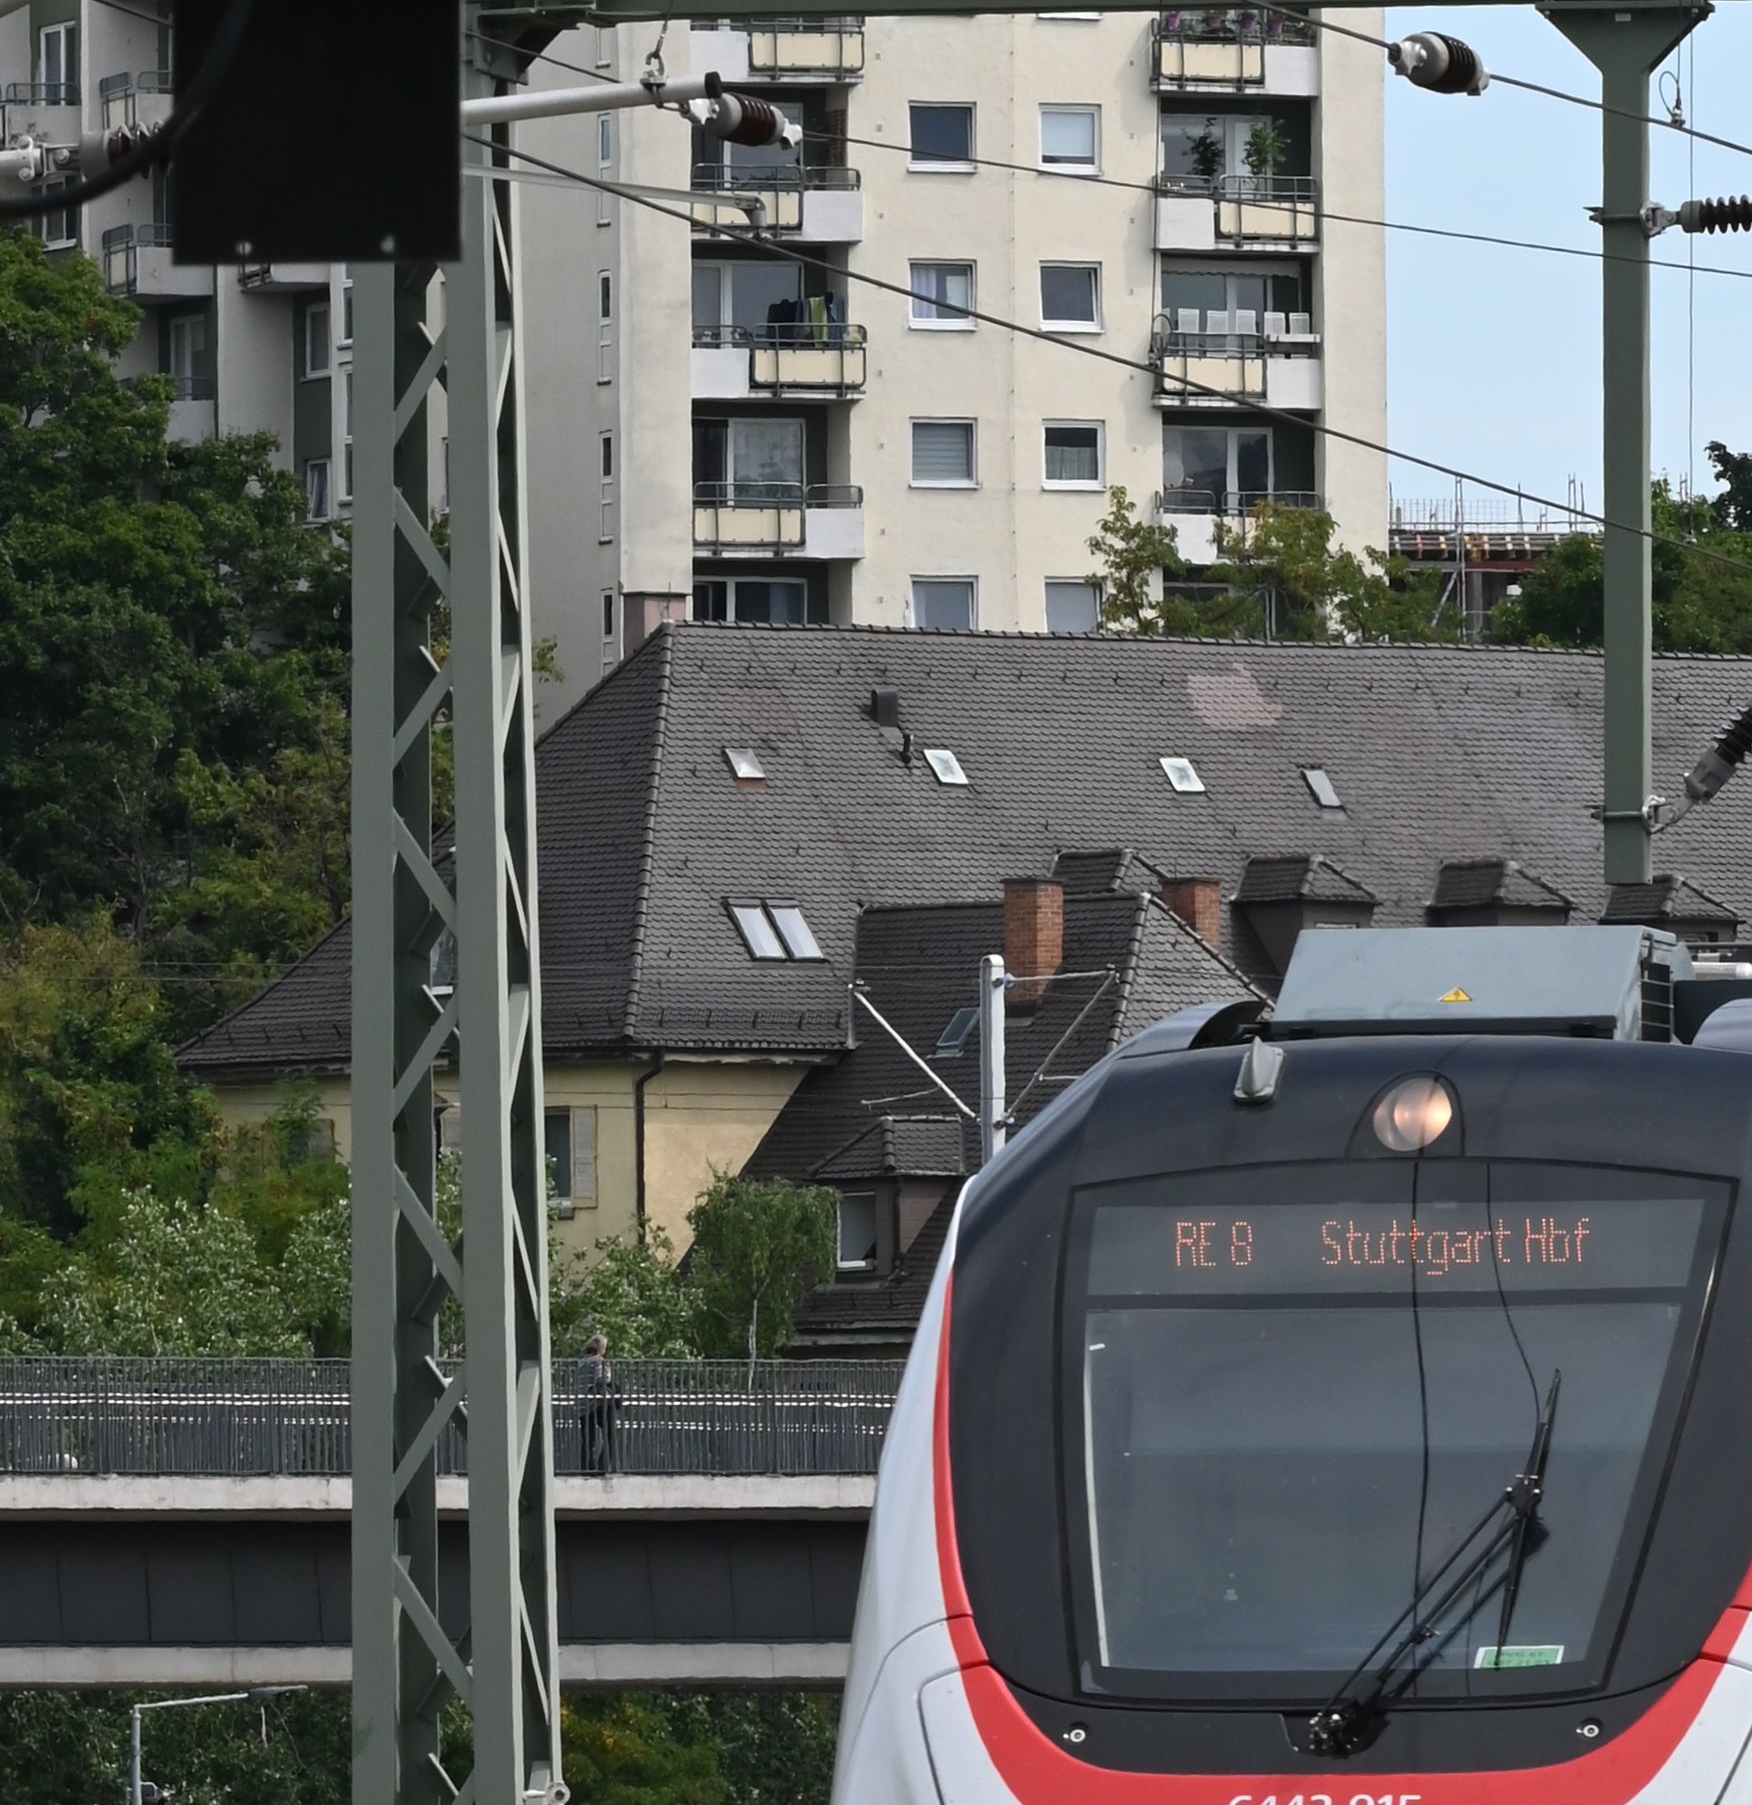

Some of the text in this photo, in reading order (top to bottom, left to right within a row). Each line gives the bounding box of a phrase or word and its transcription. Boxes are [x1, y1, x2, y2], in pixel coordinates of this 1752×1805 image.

[1176, 1217, 1591, 1276] RE 8 Stuttgart Hbf
